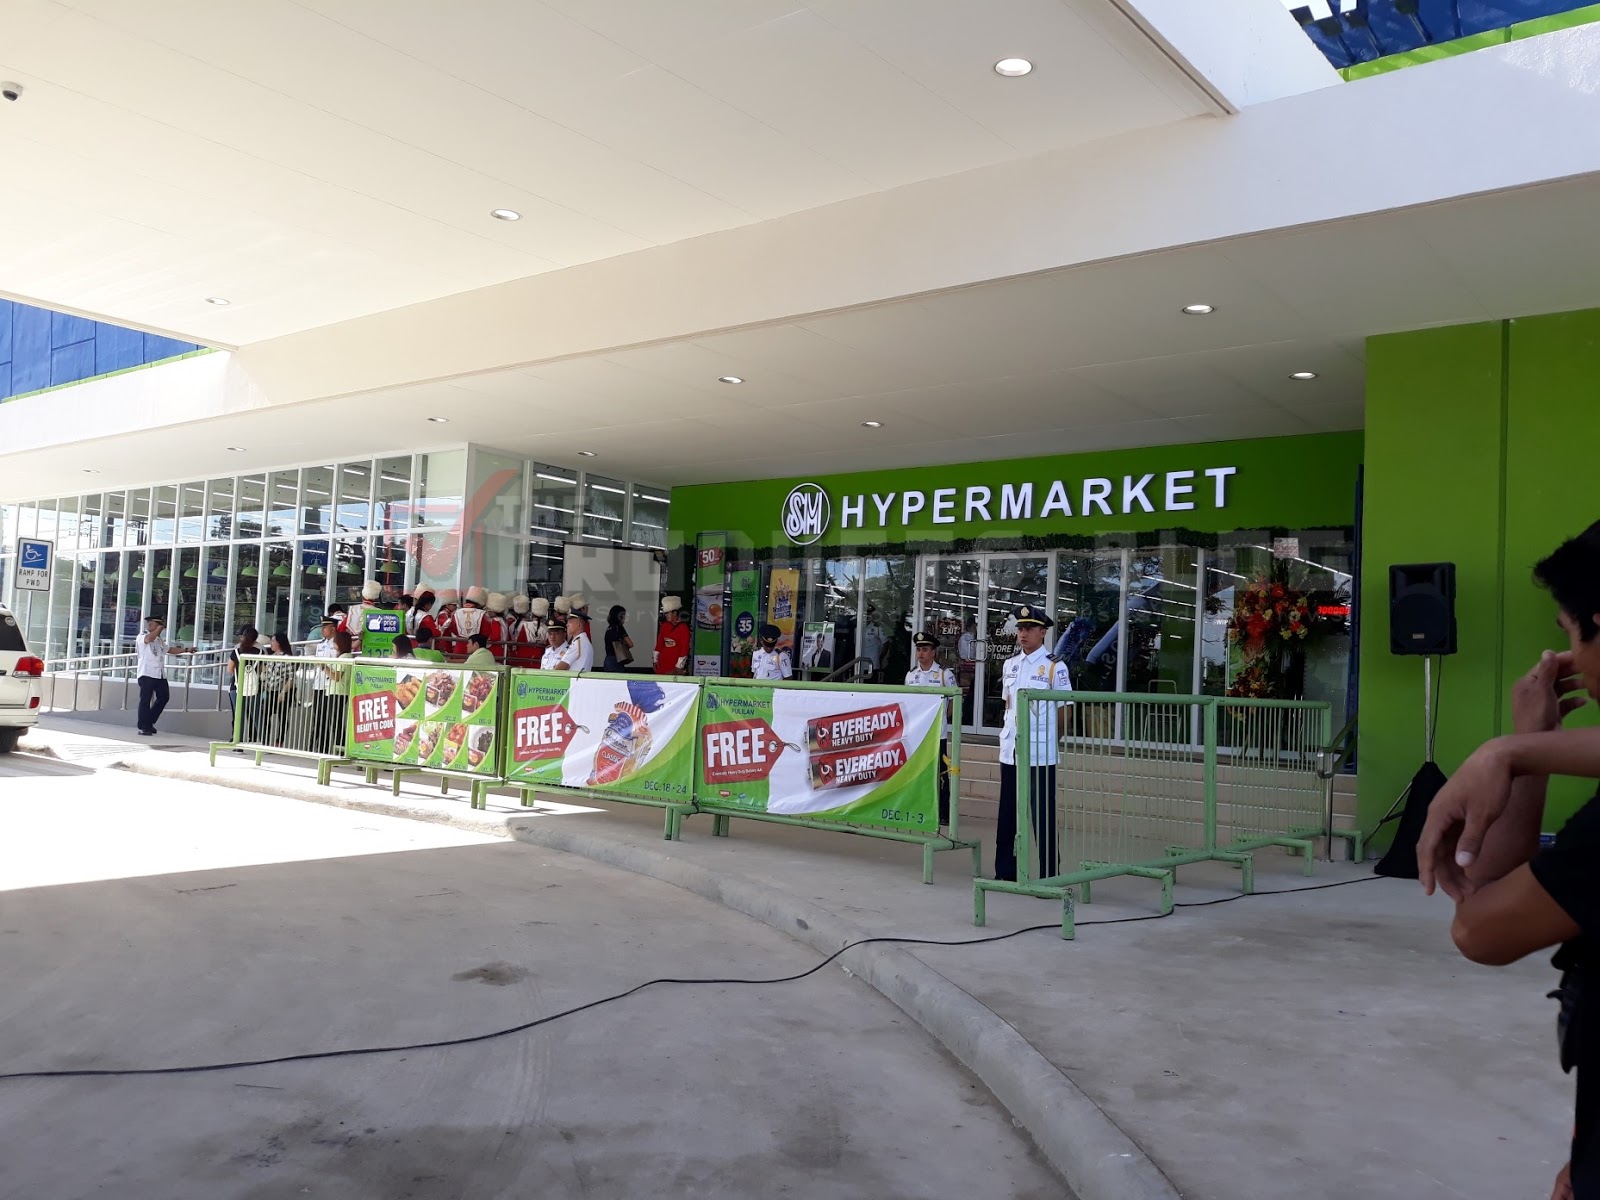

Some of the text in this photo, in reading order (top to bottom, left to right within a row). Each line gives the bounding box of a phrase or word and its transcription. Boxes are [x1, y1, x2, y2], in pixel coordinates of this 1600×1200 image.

[786, 466, 1237, 537] SM HYPERMARKET
[987, 644, 1012, 653] STORE
[528, 687, 568, 695] HYPERMARKET
[359, 696, 389, 722] FREE
[721, 699, 771, 709] HYPERMARKET
[356, 722, 373, 733] READY
[380, 719, 394, 730] COOK
[517, 712, 563, 748] FREE
[832, 710, 897, 739] EVEREADY
[832, 732, 874, 747] HEAVY DUTY
[707, 727, 766, 768] FREE
[836, 748, 901, 776] EVEREADY
[836, 770, 877, 785] HEAVY DUTY
[644, 780, 661, 791] DEC.
[663, 783, 671, 792] 18
[677, 785, 687, 794] 24
[881, 808, 904, 821] DEC.
